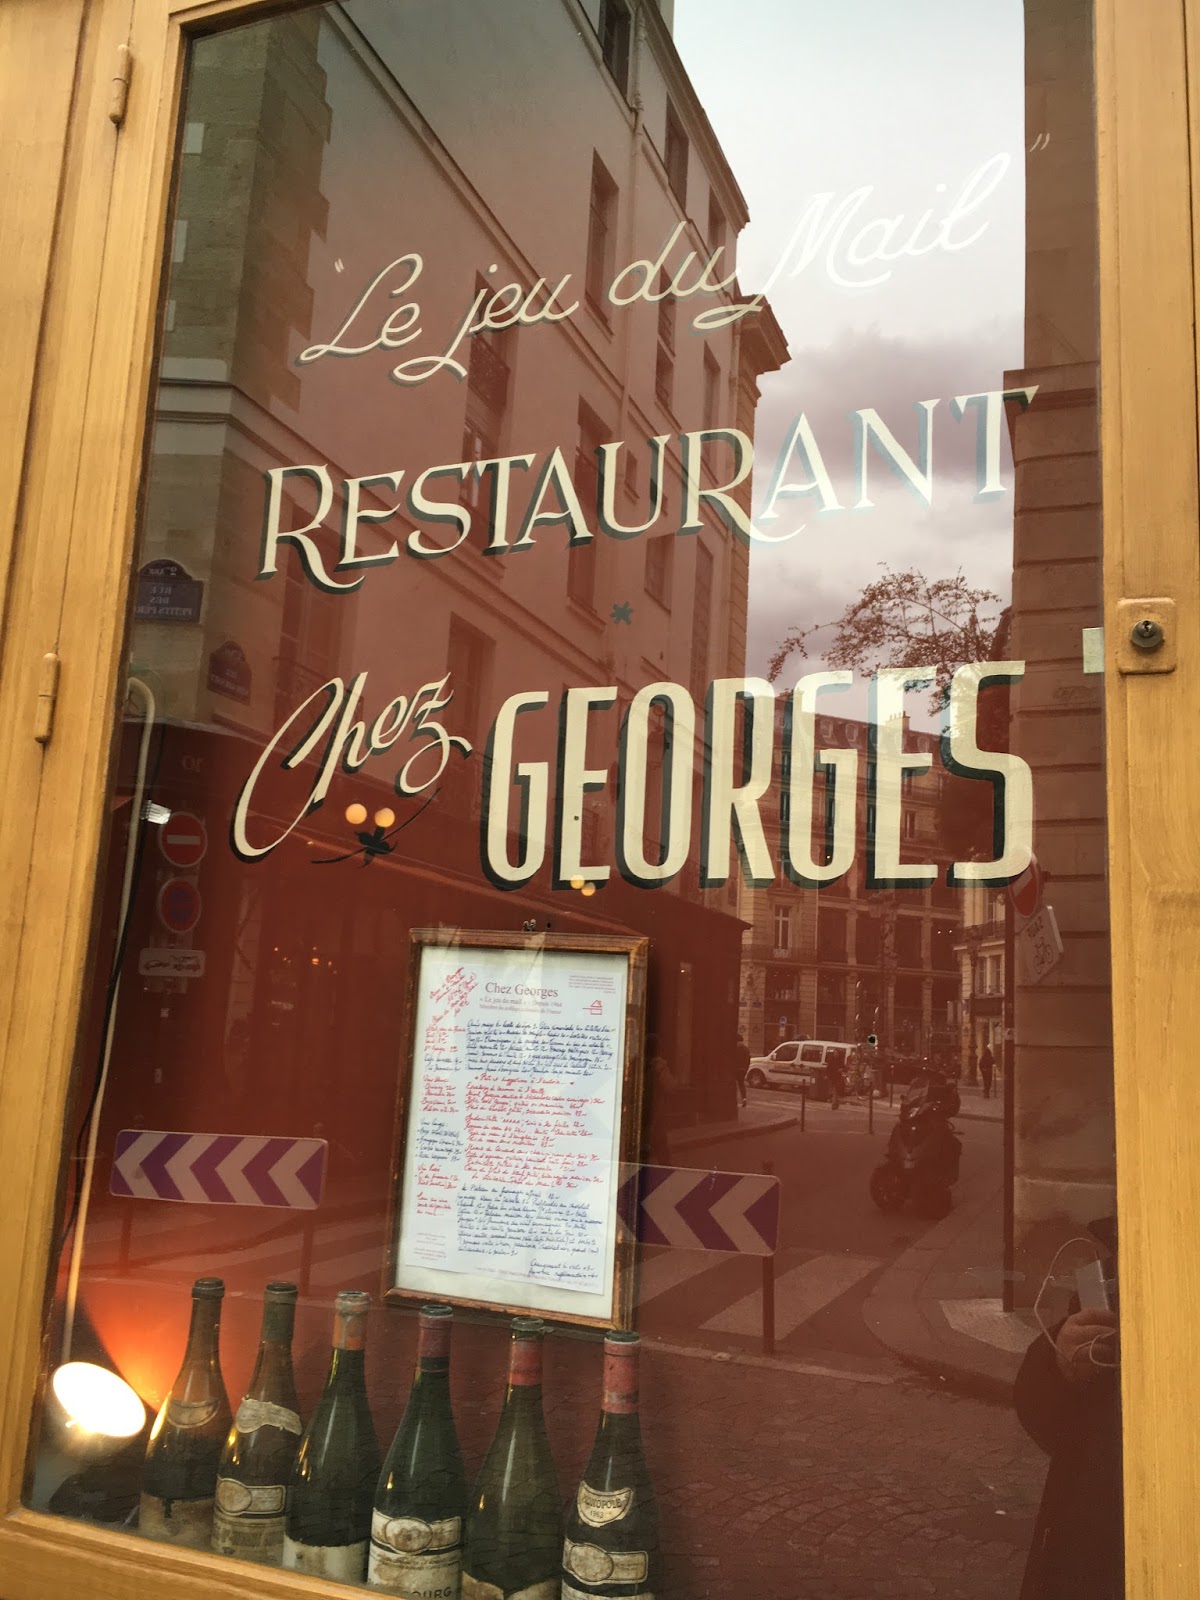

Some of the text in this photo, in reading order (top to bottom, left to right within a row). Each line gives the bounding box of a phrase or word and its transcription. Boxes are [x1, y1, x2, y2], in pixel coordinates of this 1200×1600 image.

[392, 263, 580, 383] jeu
[608, 220, 742, 308] du
[257, 385, 1039, 590] RESTAURANT
[233, 660, 1034, 882] Chez GEORGES
[485, 981, 512, 995] Chez
[514, 984, 559, 999] Georges
